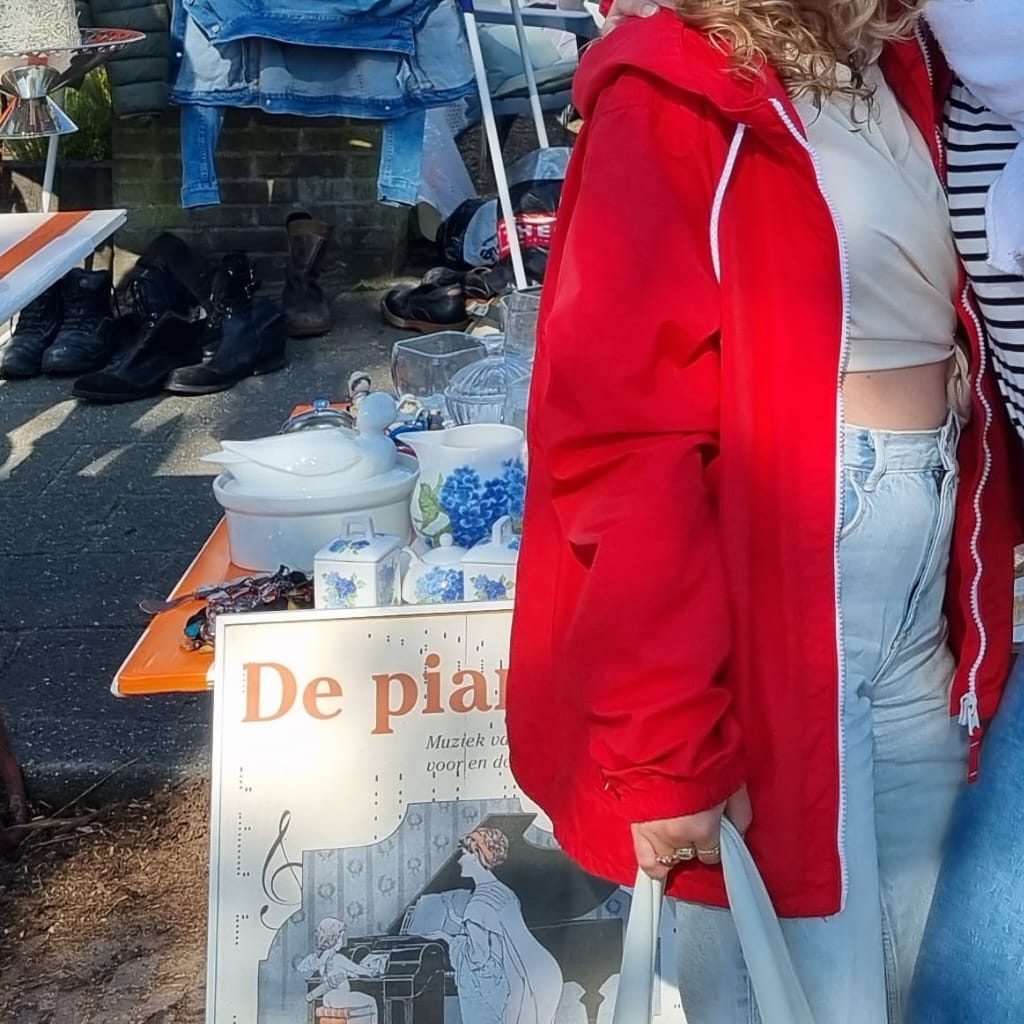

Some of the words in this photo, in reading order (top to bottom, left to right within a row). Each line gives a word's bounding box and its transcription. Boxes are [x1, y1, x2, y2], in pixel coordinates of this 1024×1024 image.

[241, 661, 343, 723] De
[425, 734, 485, 749] Muziek
[426, 760, 463, 772] voor
[468, 758, 487, 770] en
